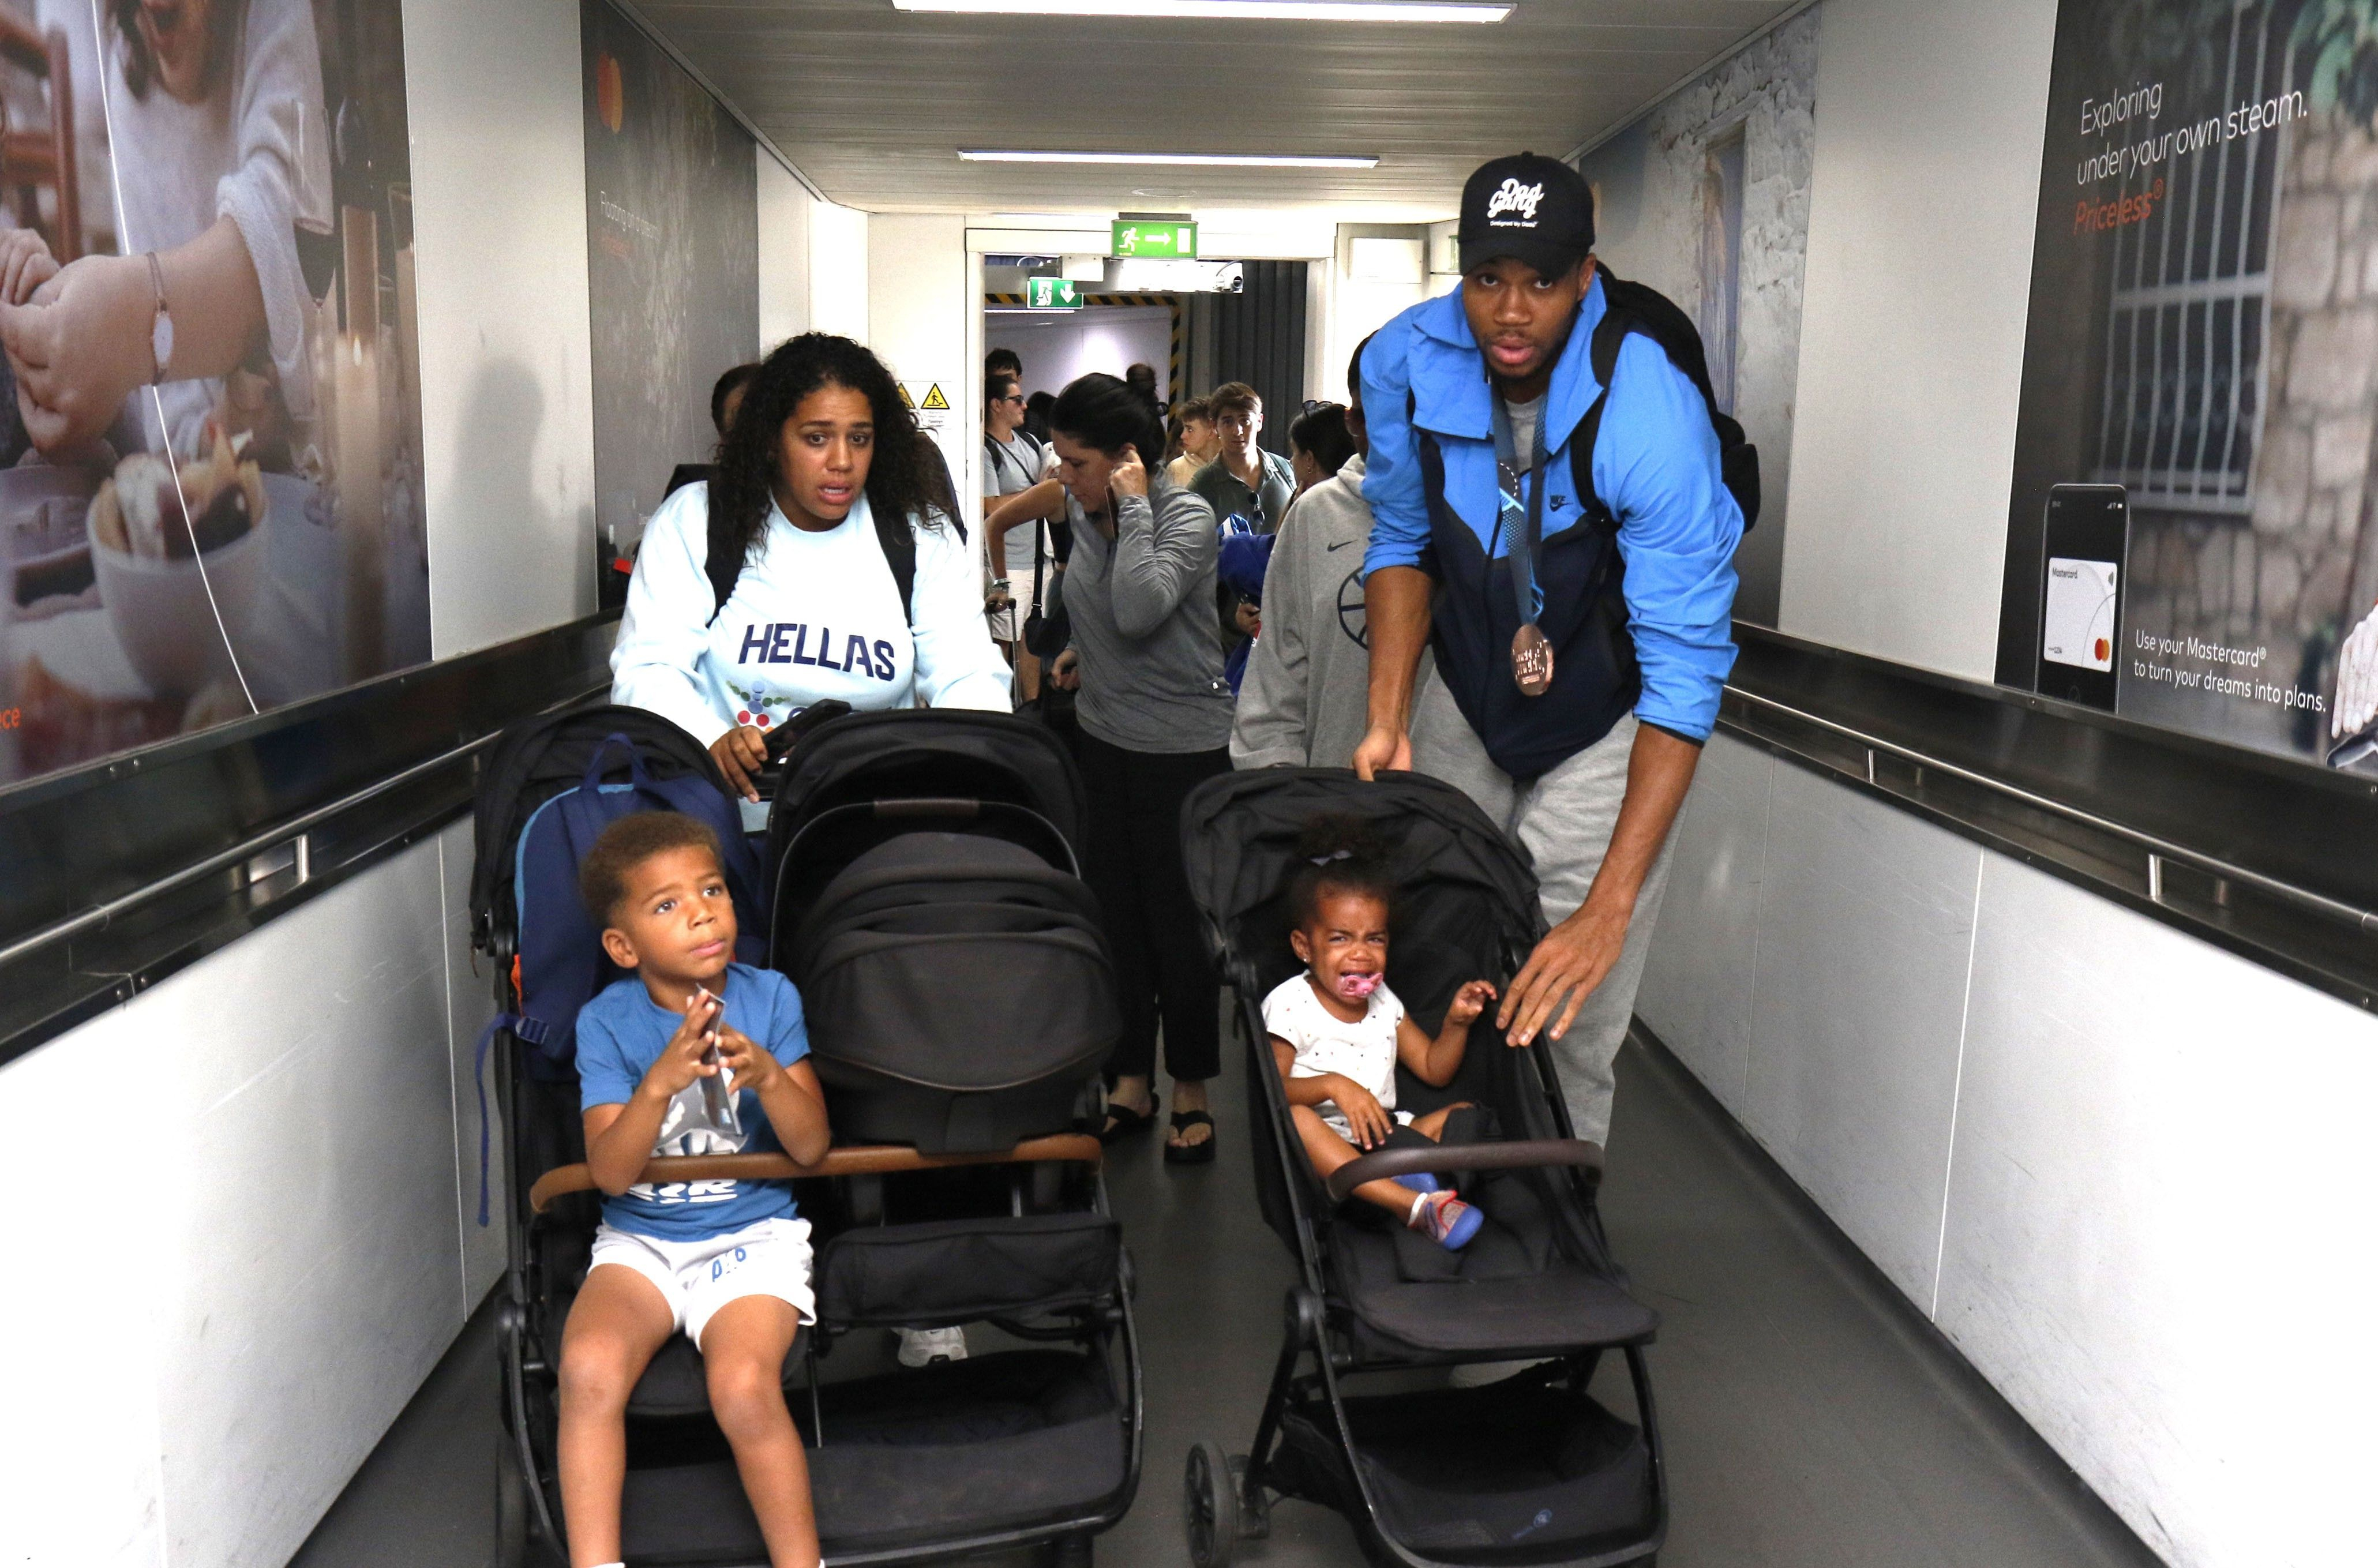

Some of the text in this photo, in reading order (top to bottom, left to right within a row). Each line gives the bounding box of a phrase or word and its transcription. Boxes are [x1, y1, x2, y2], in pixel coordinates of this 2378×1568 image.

[2080, 81, 2163, 137] Exploring
[2077, 90, 2308, 186] under your own steam.
[738, 623, 895, 682] HELLAS
[2136, 629, 2156, 650] Use
[2158, 637, 2184, 657] your
[2134, 659, 2327, 712] to turn your dreams into plans.
[0, 707, 21, 730] ce
